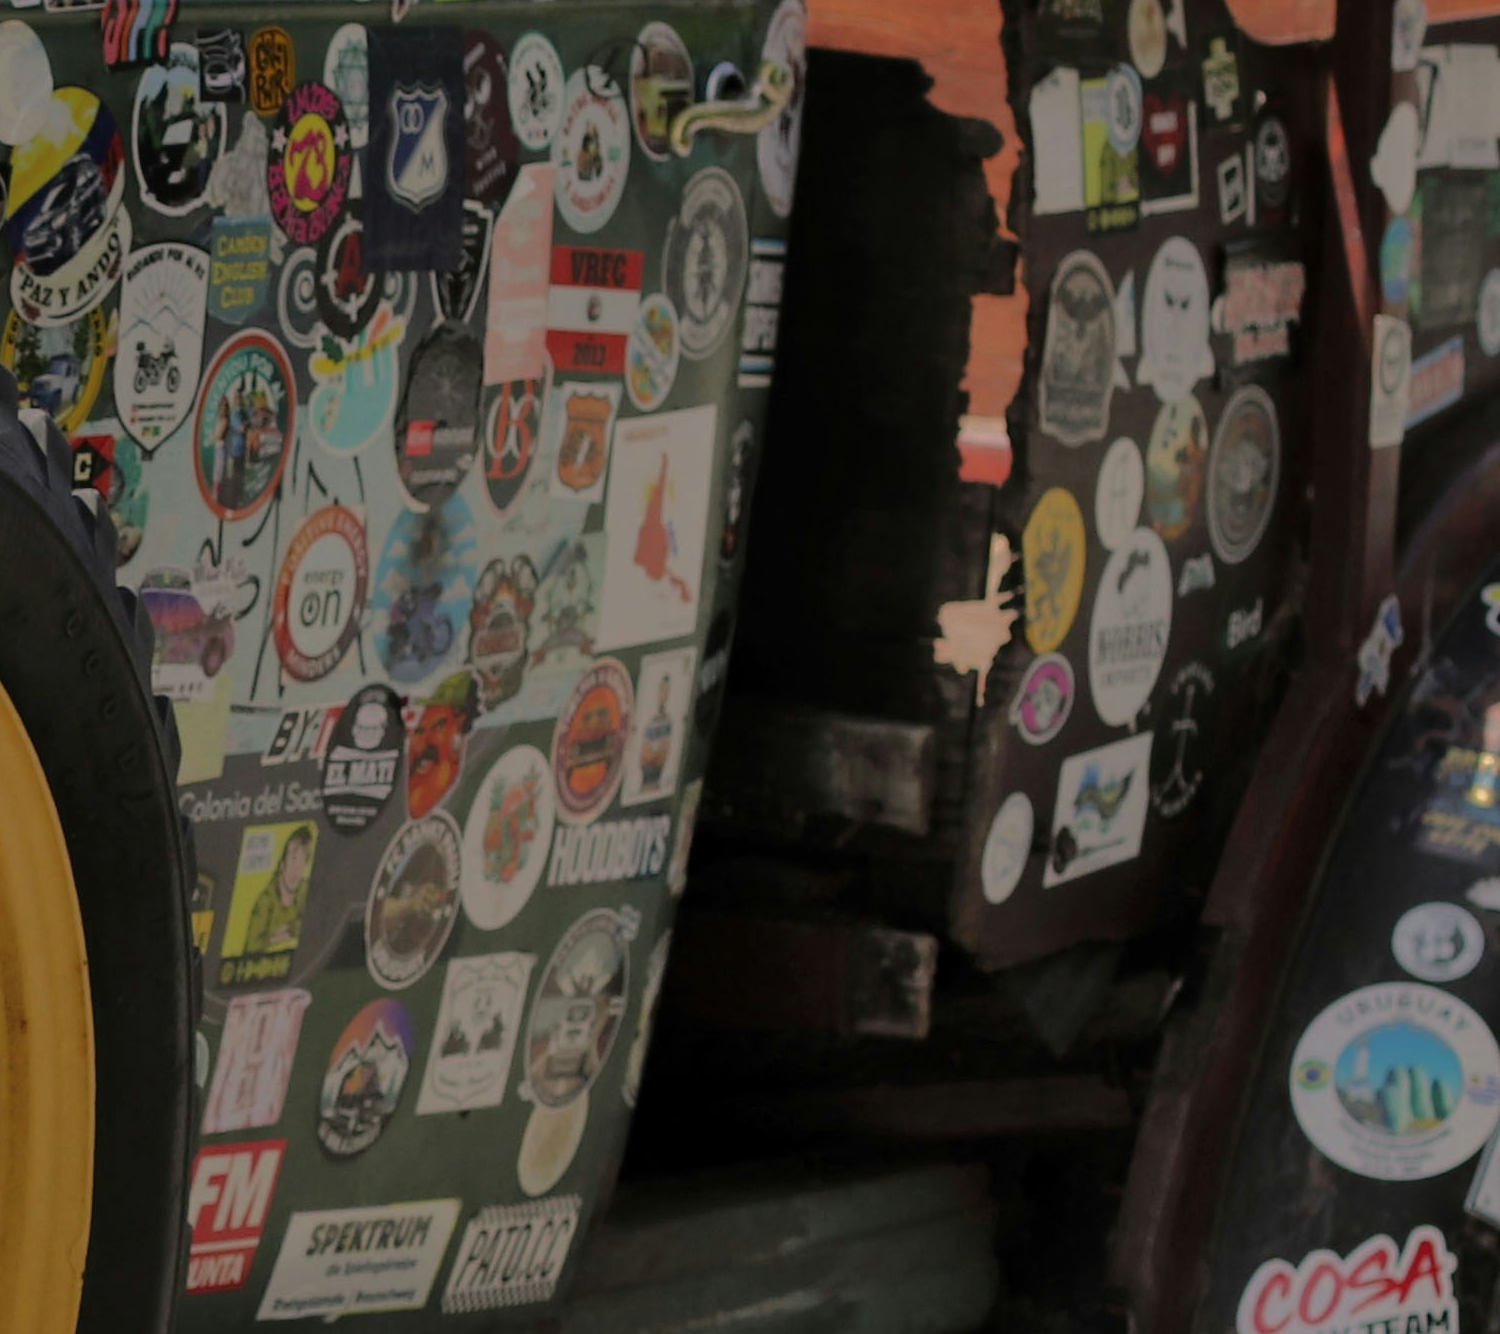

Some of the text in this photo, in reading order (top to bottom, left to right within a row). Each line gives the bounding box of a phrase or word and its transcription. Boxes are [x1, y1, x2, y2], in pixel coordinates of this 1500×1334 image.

[570, 252, 627, 288] VRFC
[220, 288, 256, 308] CLUB
[1225, 599, 1265, 651] Bird
[181, 786, 281, 820] Colonia del
[547, 816, 670, 886] HOODBOYS
[194, 1147, 279, 1231] FM
[305, 1216, 431, 1256] SPEKTRUM
[461, 1219, 573, 1288] PATO.CC
